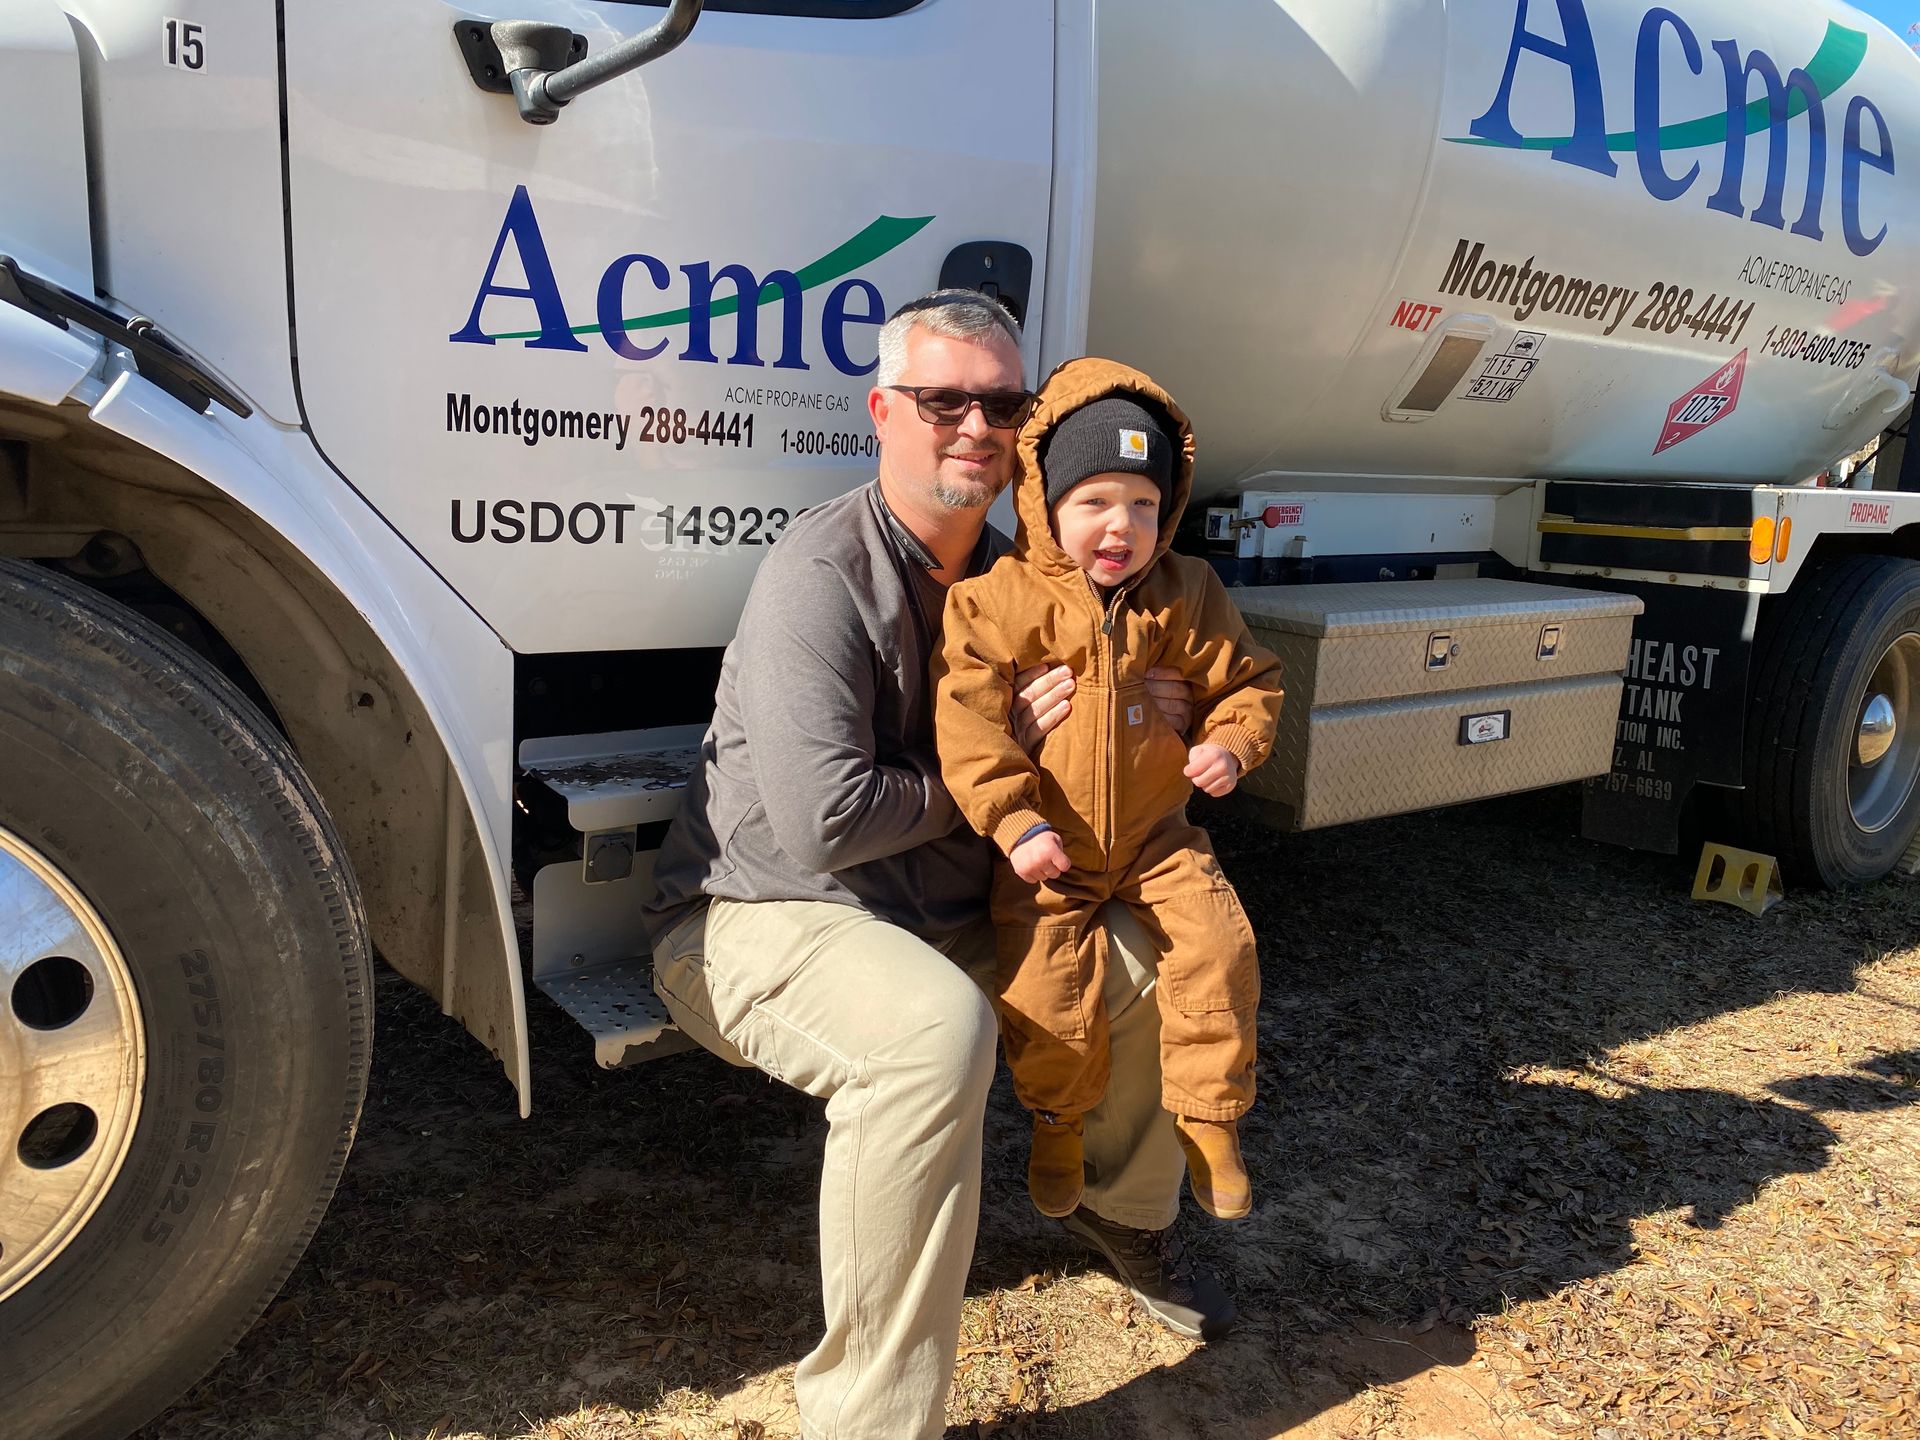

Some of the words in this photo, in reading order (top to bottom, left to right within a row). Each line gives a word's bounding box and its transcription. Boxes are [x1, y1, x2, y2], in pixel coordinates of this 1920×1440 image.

[166, 20, 204, 70] 15
[1468, 0, 1896, 257] Acme
[448, 184, 887, 377] Acme
[1438, 238, 1639, 336] Montgomery
[1632, 281, 1756, 344] 288-4441
[1737, 255, 1780, 288] ACME
[1774, 263, 1830, 300] PROPANE
[1825, 276, 1852, 306] GAS
[1760, 324, 1872, 369] 1-800-600-0765
[724, 386, 763, 405] ACME
[766, 389, 823, 410] PROPANE
[825, 394, 850, 412] GAS
[1675, 394, 1729, 424] 1075
[446, 393, 631, 451] Montgomery
[639, 406, 755, 449] 288-4441
[1664, 431, 1681, 445] 2
[451, 499, 636, 546] USDOT
[656, 504, 810, 547] 14923
[1849, 502, 1890, 524] PROPANE
[1627, 684, 1684, 723] TANK
[1656, 726, 1685, 750] INC.
[1636, 750, 1656, 773] AL
